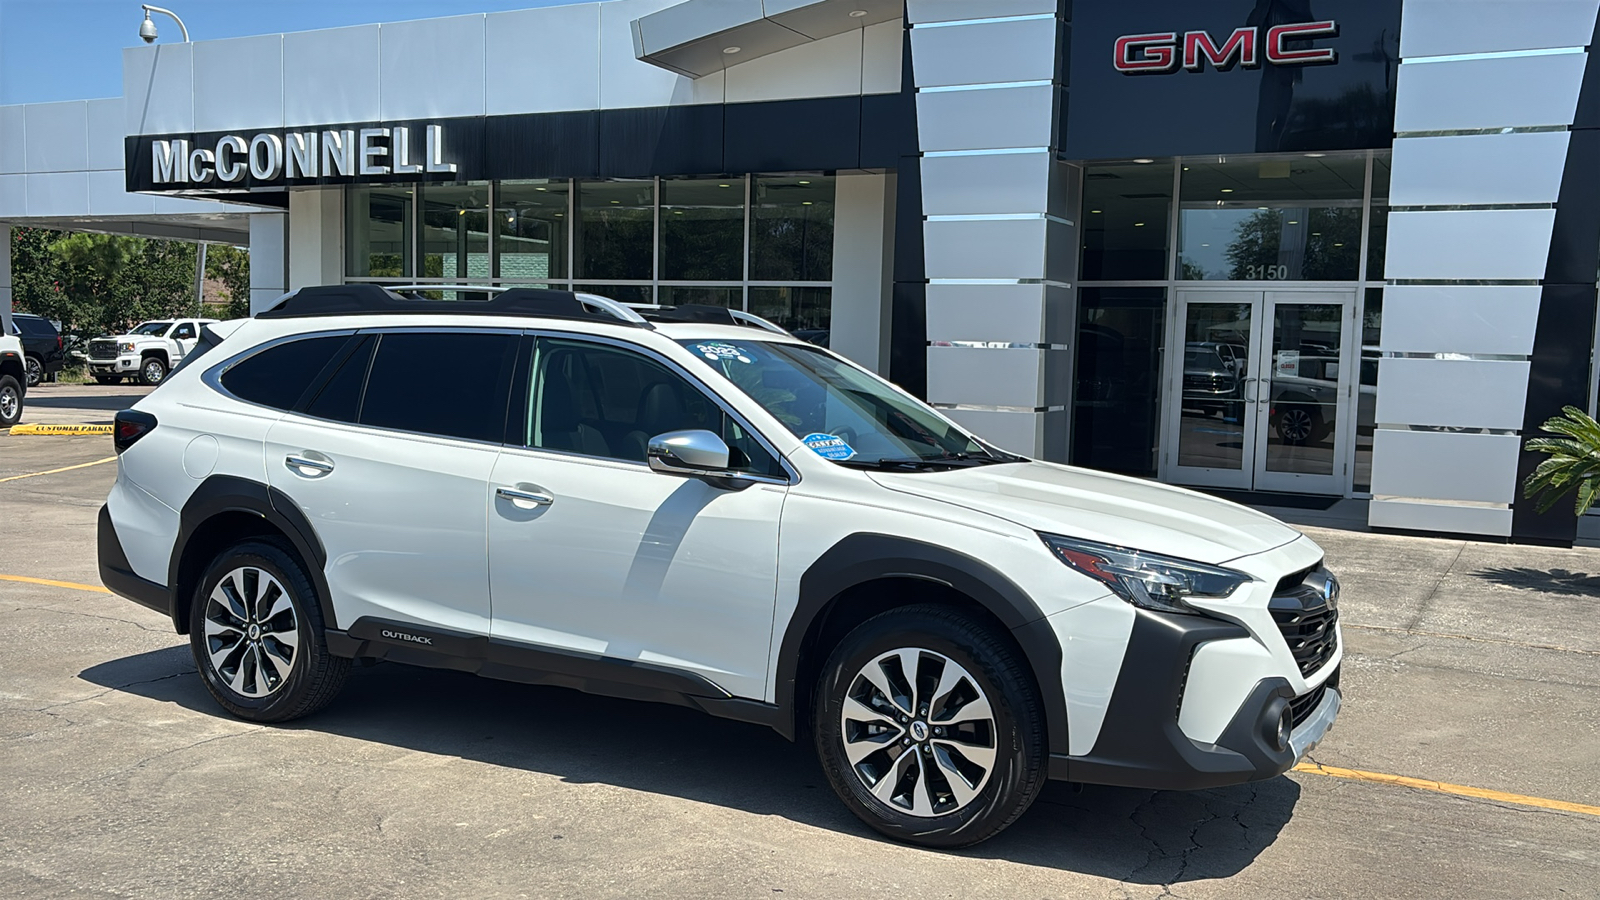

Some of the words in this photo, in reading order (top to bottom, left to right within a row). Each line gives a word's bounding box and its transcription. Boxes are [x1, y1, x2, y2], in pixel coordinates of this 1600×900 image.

[1113, 20, 1337, 74] GMC
[152, 124, 457, 183] McCONNELL
[1246, 264, 1288, 280] 3150
[381, 629, 433, 645] OUTBACK
